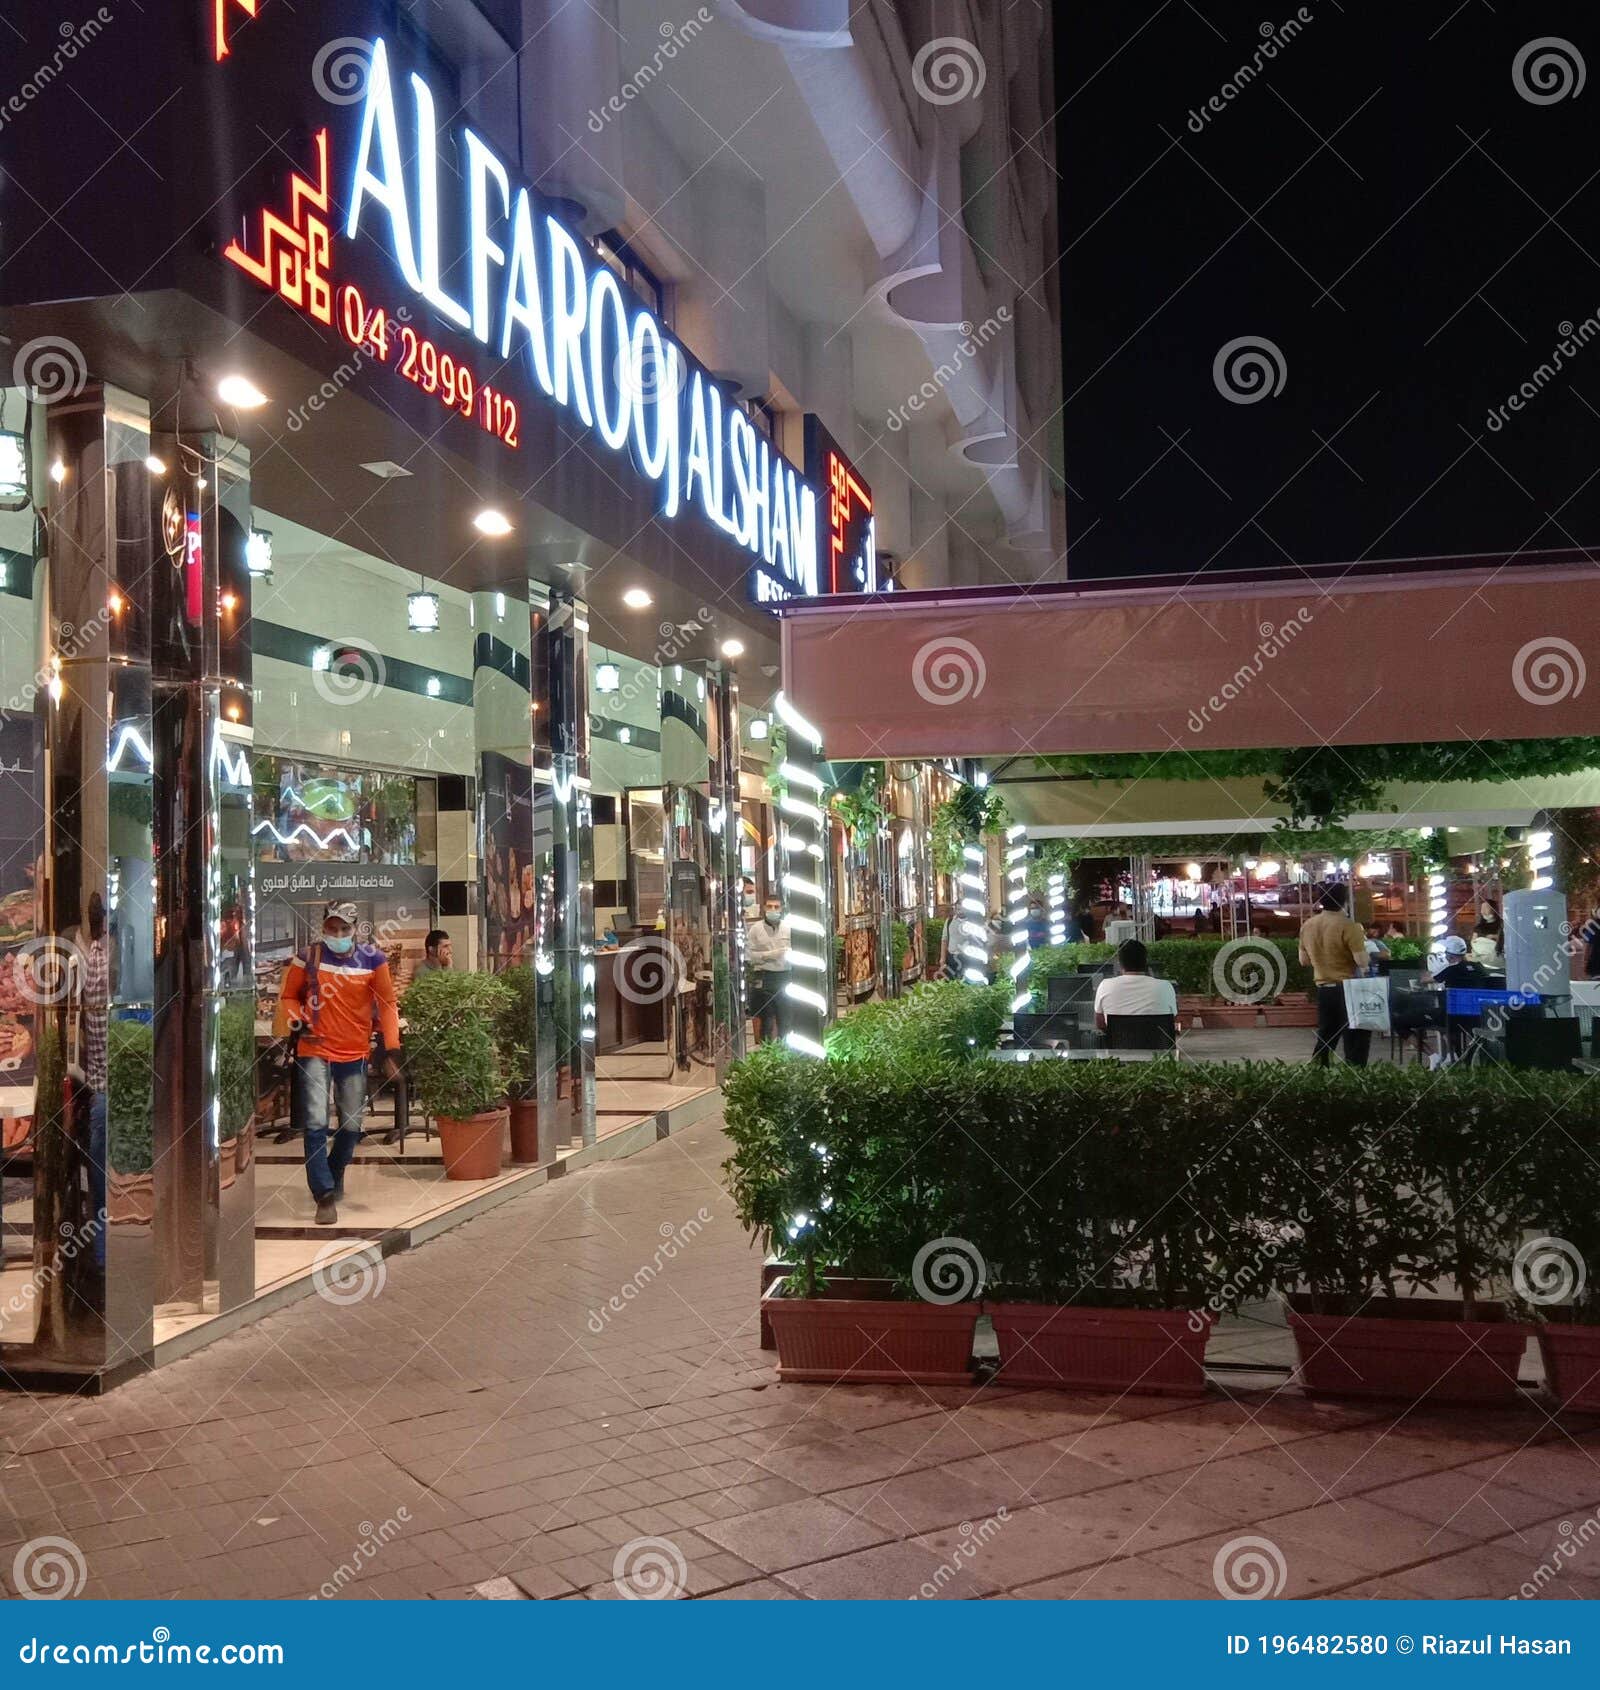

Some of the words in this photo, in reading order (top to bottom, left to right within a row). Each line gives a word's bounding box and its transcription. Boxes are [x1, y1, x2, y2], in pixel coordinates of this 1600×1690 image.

[344, 284, 388, 360] 04
[401, 327, 473, 417] 2999
[483, 386, 518, 448] 112
[316, 875, 328, 896] في
